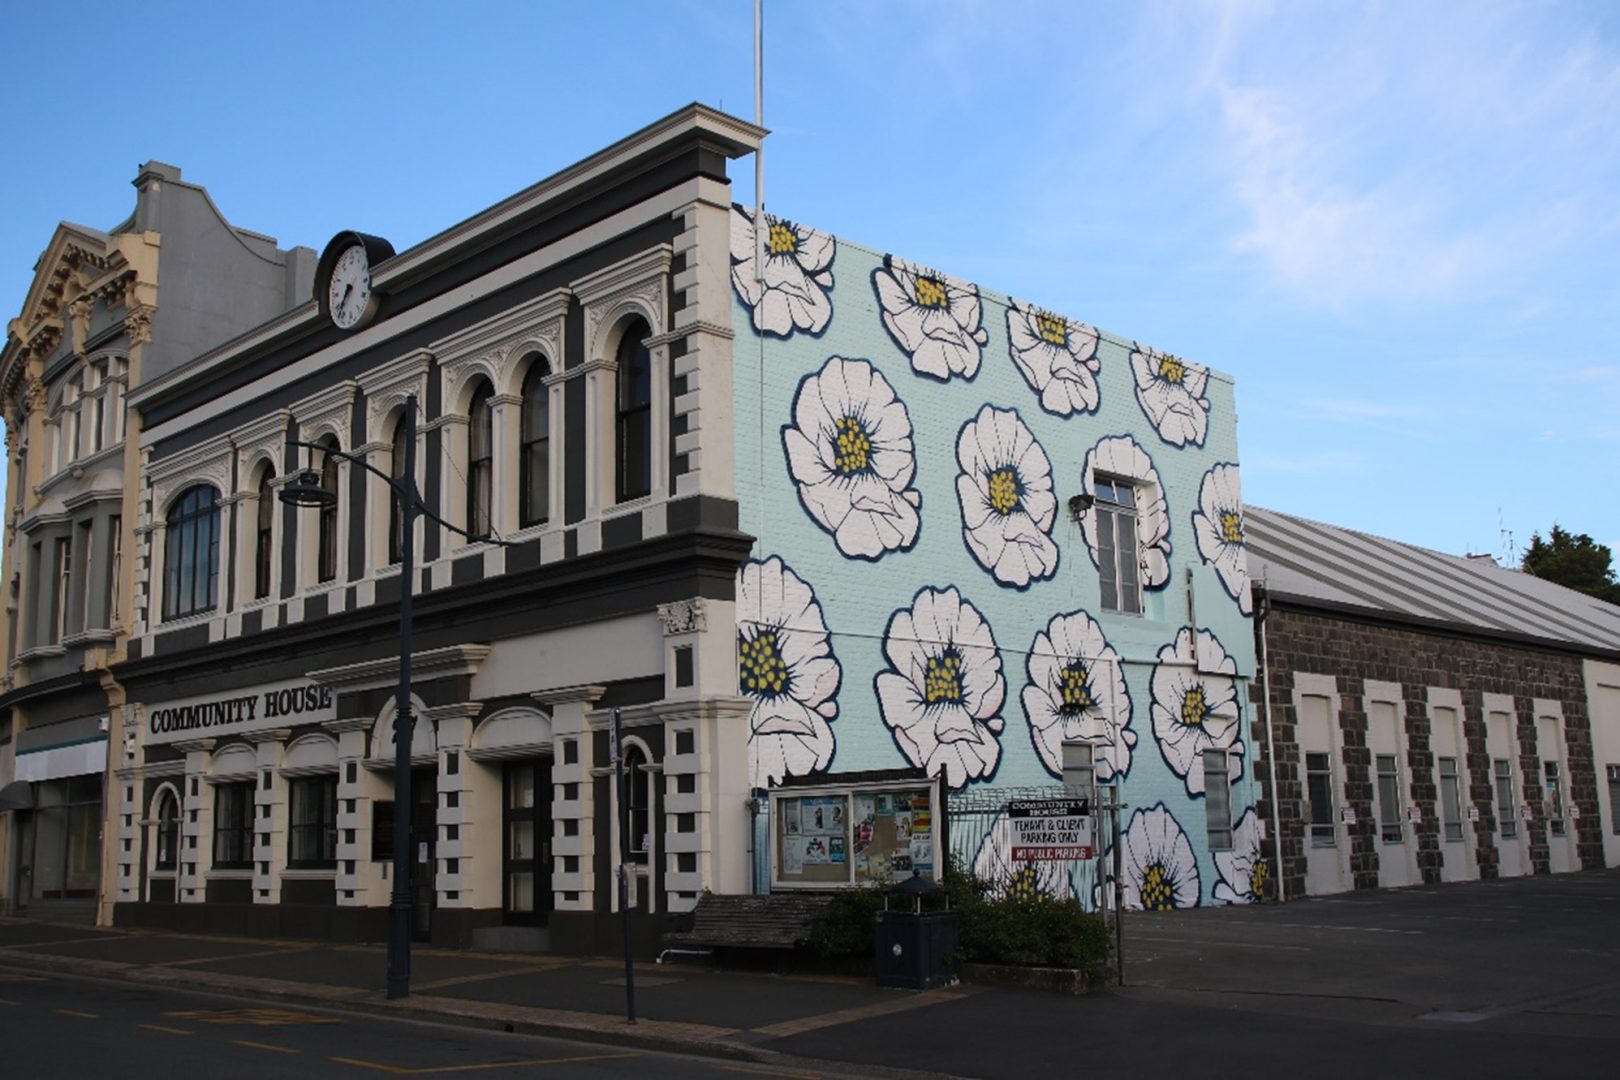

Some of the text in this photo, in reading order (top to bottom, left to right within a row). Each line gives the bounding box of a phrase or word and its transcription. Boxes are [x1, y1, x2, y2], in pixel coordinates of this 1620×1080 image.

[151, 683, 333, 734] COMMUNITY HOUSE
[1012, 801, 1084, 810] COMMUNITY
[1014, 818, 1085, 831] TENANT & CLIENT
[1020, 832, 1079, 843] PARKING ONLY
[1016, 847, 1087, 859] NO PUBLIC PARKING
